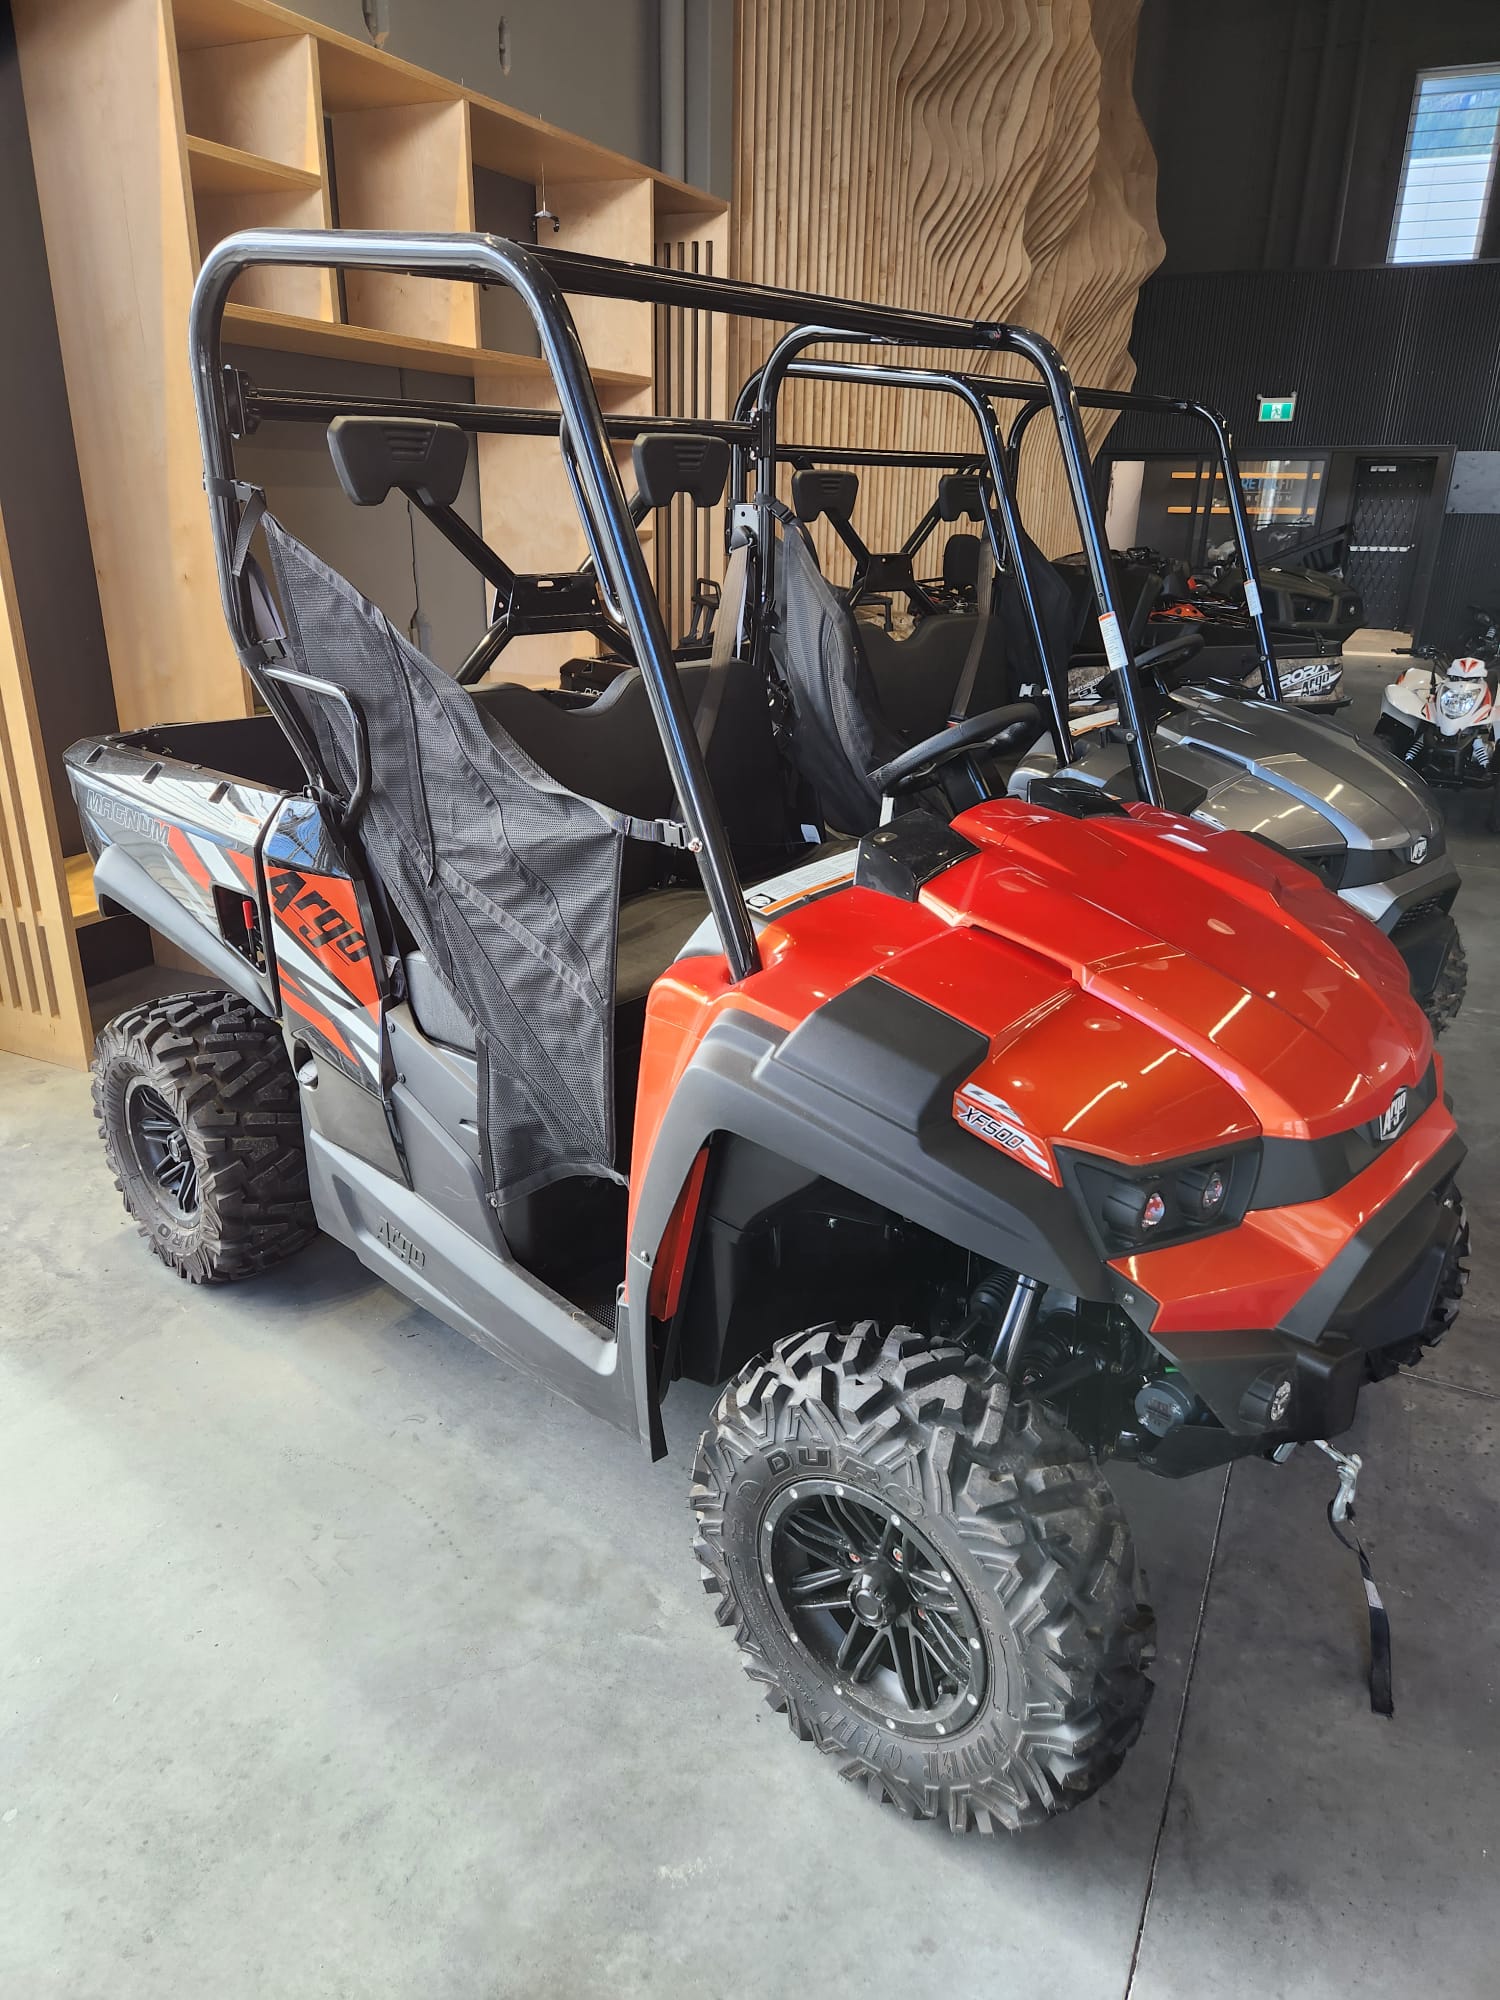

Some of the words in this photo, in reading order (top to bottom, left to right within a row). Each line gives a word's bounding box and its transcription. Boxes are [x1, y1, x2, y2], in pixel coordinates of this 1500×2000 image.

[1241, 478, 1294, 490] RETLFIT
[1257, 665, 1329, 699] ARORA
[87, 789, 171, 847] MAGNUM
[270, 871, 369, 962] Argo
[959, 1106, 1025, 1149] XF500
[1383, 1091, 1407, 1136] Argo
[376, 1216, 426, 1270] Argo
[764, 1447, 924, 1516] DURO
